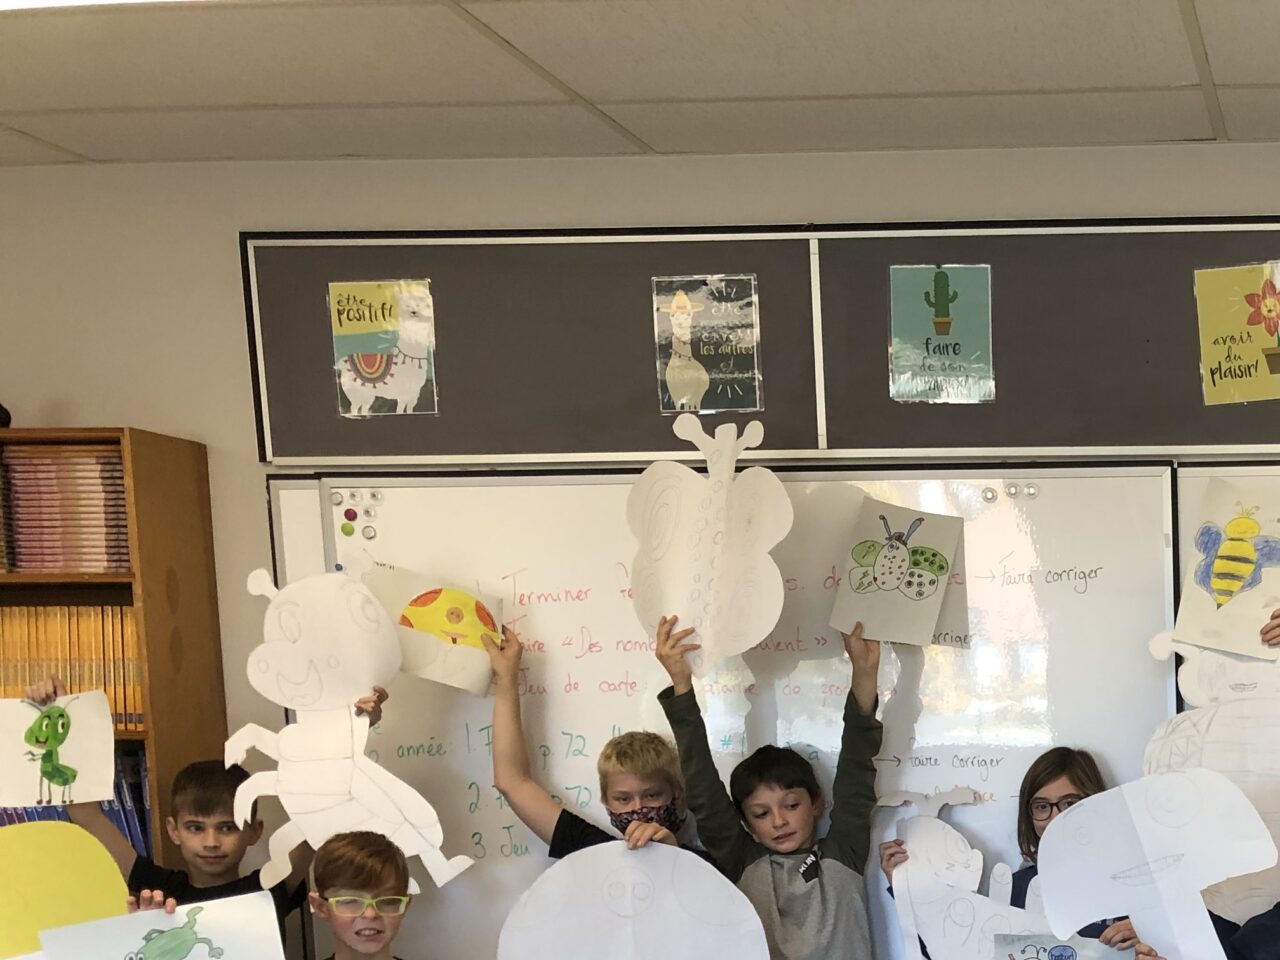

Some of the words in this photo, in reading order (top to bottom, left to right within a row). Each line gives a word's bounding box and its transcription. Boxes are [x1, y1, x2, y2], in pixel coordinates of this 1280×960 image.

[337, 293, 373, 306] être
[923, 337, 961, 356] faire
[1212, 331, 1253, 346] avoir
[1224, 345, 1242, 364] du
[1210, 360, 1259, 388] plaisir!
[502, 568, 592, 606] Terminer
[1045, 566, 1103, 594] corriger
[564, 672, 579, 693] de
[561, 731, 589, 758] 72
[565, 785, 592, 808] 72
[500, 825, 530, 857] Jeu
